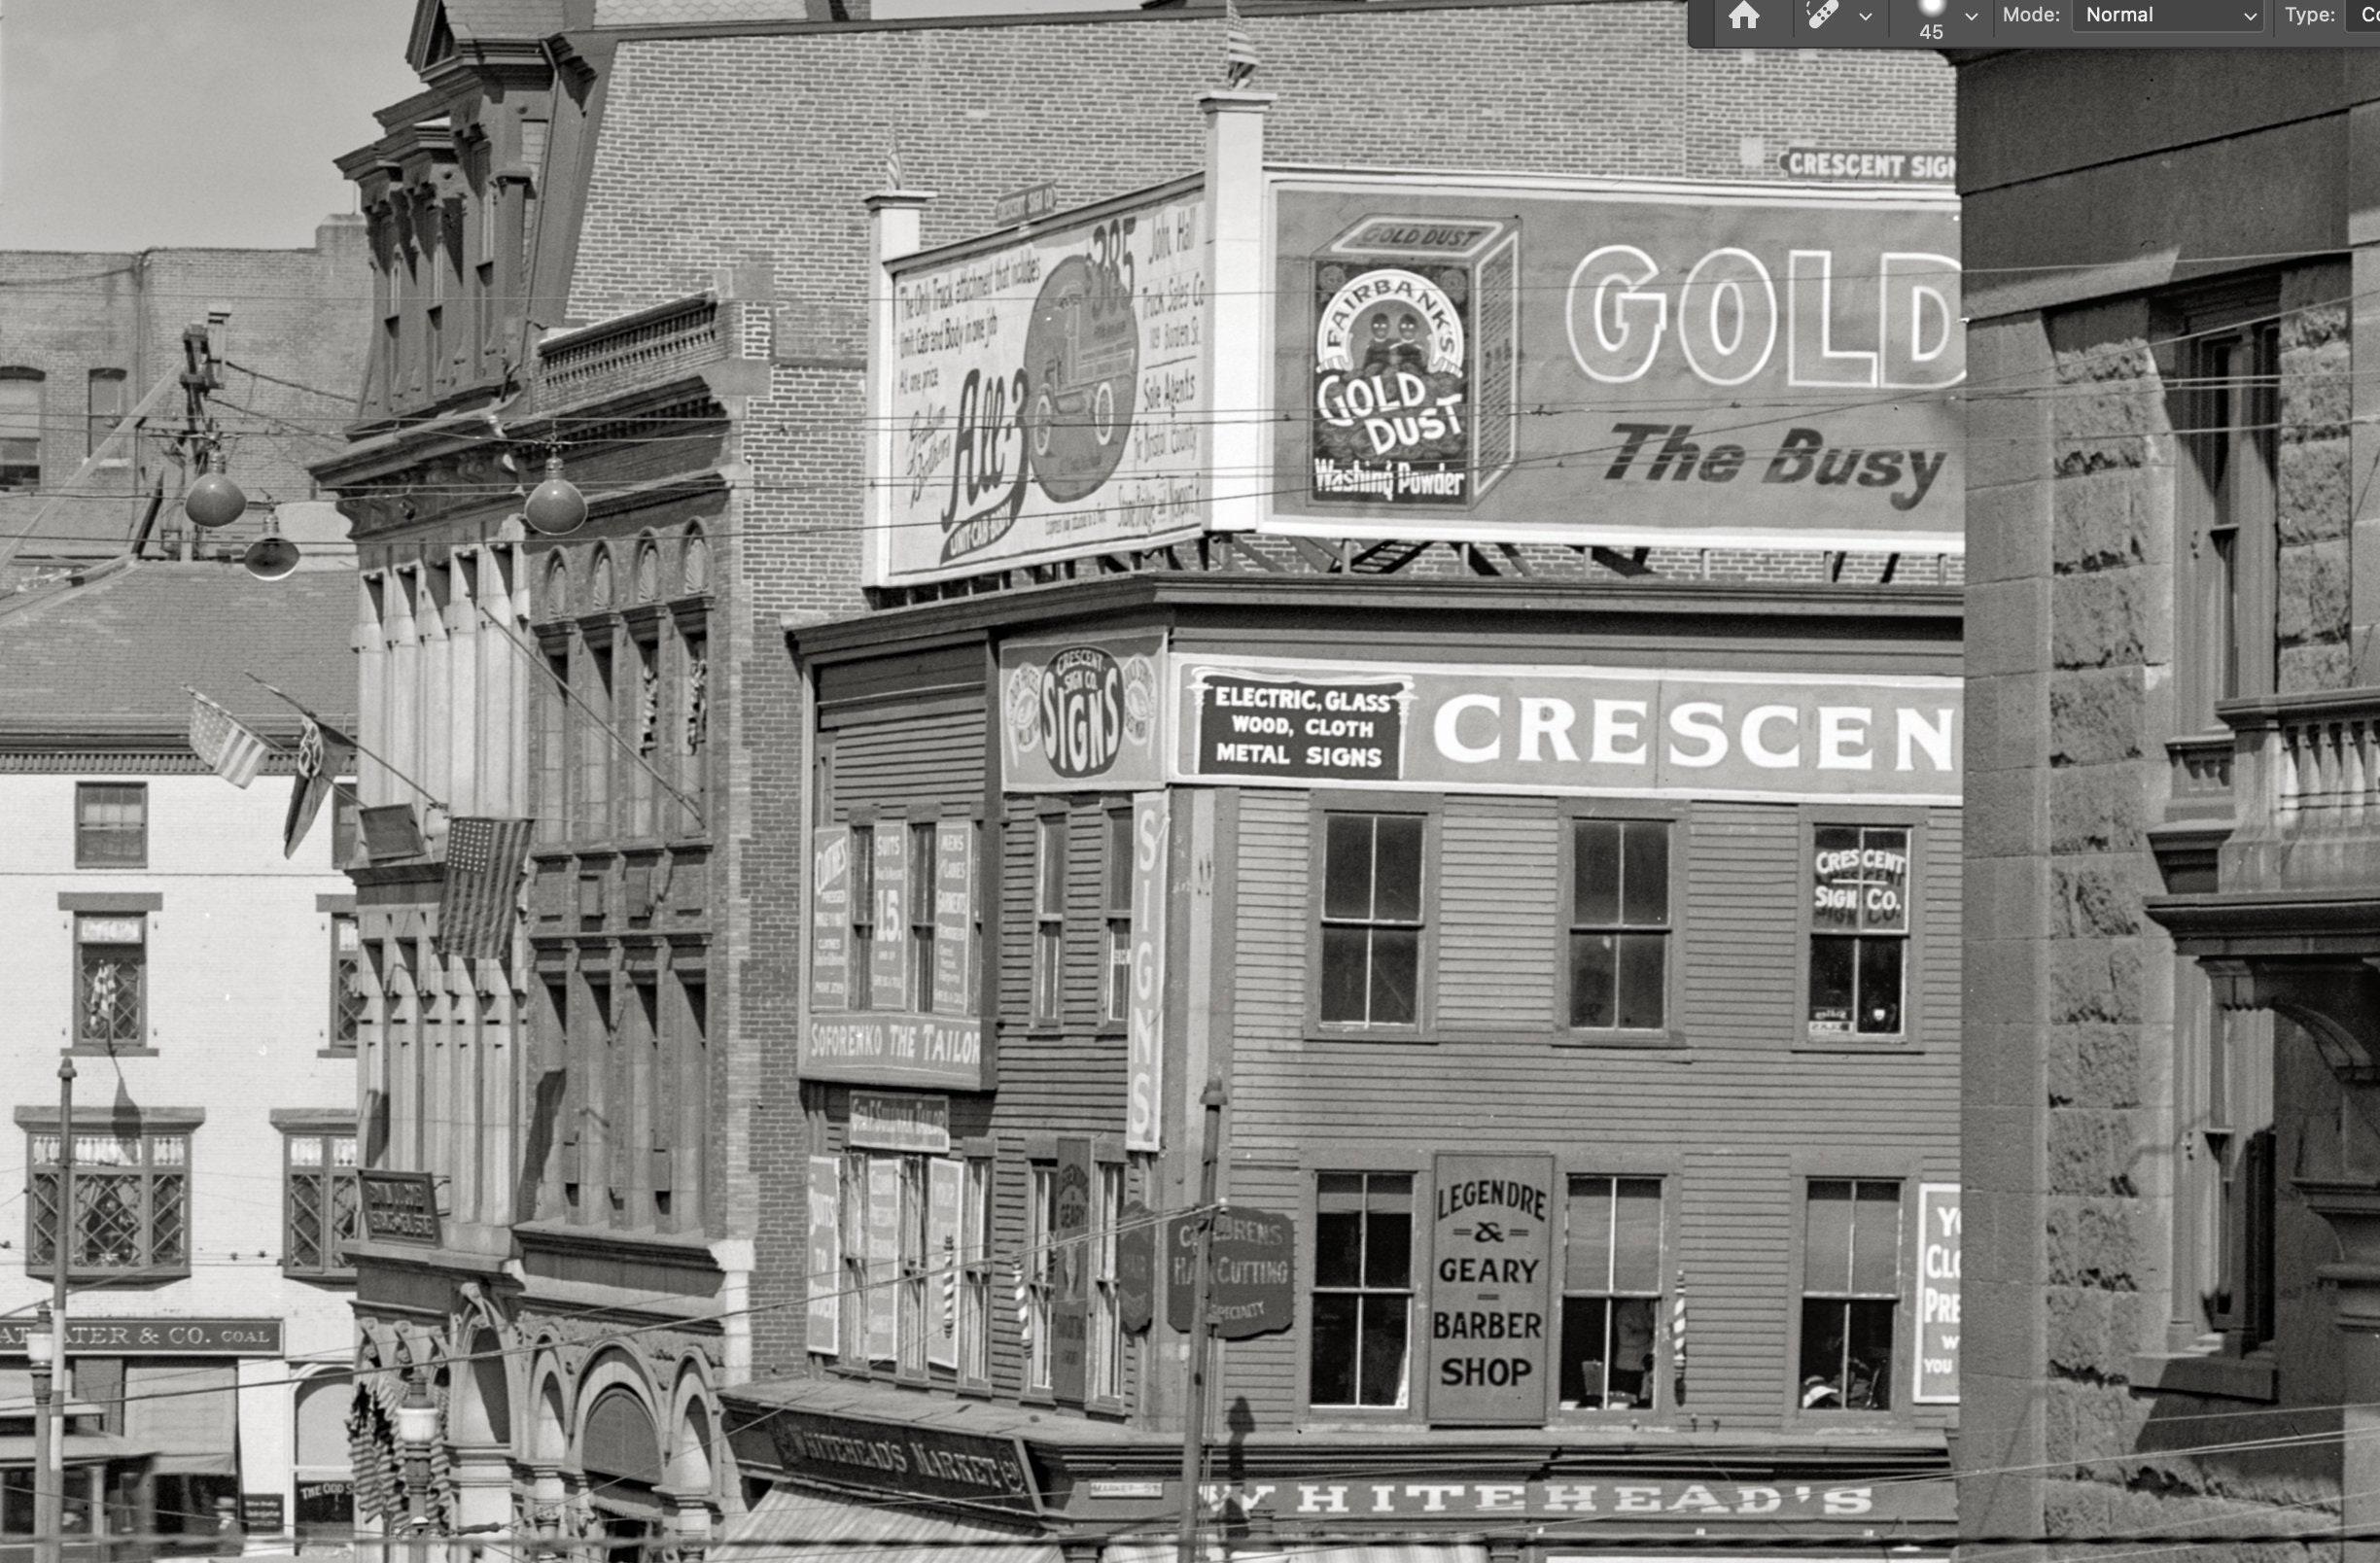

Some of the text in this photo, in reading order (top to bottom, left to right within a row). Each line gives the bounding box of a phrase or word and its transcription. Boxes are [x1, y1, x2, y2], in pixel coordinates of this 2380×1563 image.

[1790, 153, 1907, 178] CRESCENT
[1363, 227, 1483, 248] GOLD DUST
[1326, 278, 1455, 355] FAIRBANK'S
[1566, 245, 1966, 388] GOLD
[1317, 371, 1463, 456] GOLD DUST
[1314, 458, 1466, 502] Washing Powder
[1604, 423, 1947, 511] The Busy
[1057, 649, 1103, 677] CRESCENT
[1215, 685, 1392, 713] ELECTRIC, GLASS
[1042, 667, 1119, 773] SIGNS
[1232, 714, 1375, 739] WOOD, CLOTH
[1216, 742, 1382, 768] METAL SIGNS
[1816, 849, 1906, 874] CRESCENT
[1814, 886, 1902, 911] SIGN CO.
[1132, 809, 1156, 1135] SIGNS
[811, 1023, 981, 1064] SOFORENKO THE TAILOR
[1438, 1179, 1547, 1223] LEGENDRE
[1474, 1222, 1505, 1243] &
[1217, 1257, 1288, 1284] CUTTING
[1439, 1258, 1540, 1284] GEARY
[139, 1328, 159, 1344] &
[169, 1327, 211, 1344] CO.
[222, 1331, 270, 1343] COAL
[1433, 1311, 1542, 1340] BARBER
[1441, 1356, 1532, 1387] SHOP
[1924, 1359, 1953, 1374] YOU
[909, 1441, 1002, 1488] MARKET
[300, 1485, 322, 1500] THE
[323, 1482, 344, 1495] ODD
[1198, 1482, 1872, 1518] WHITEHEAD'S
